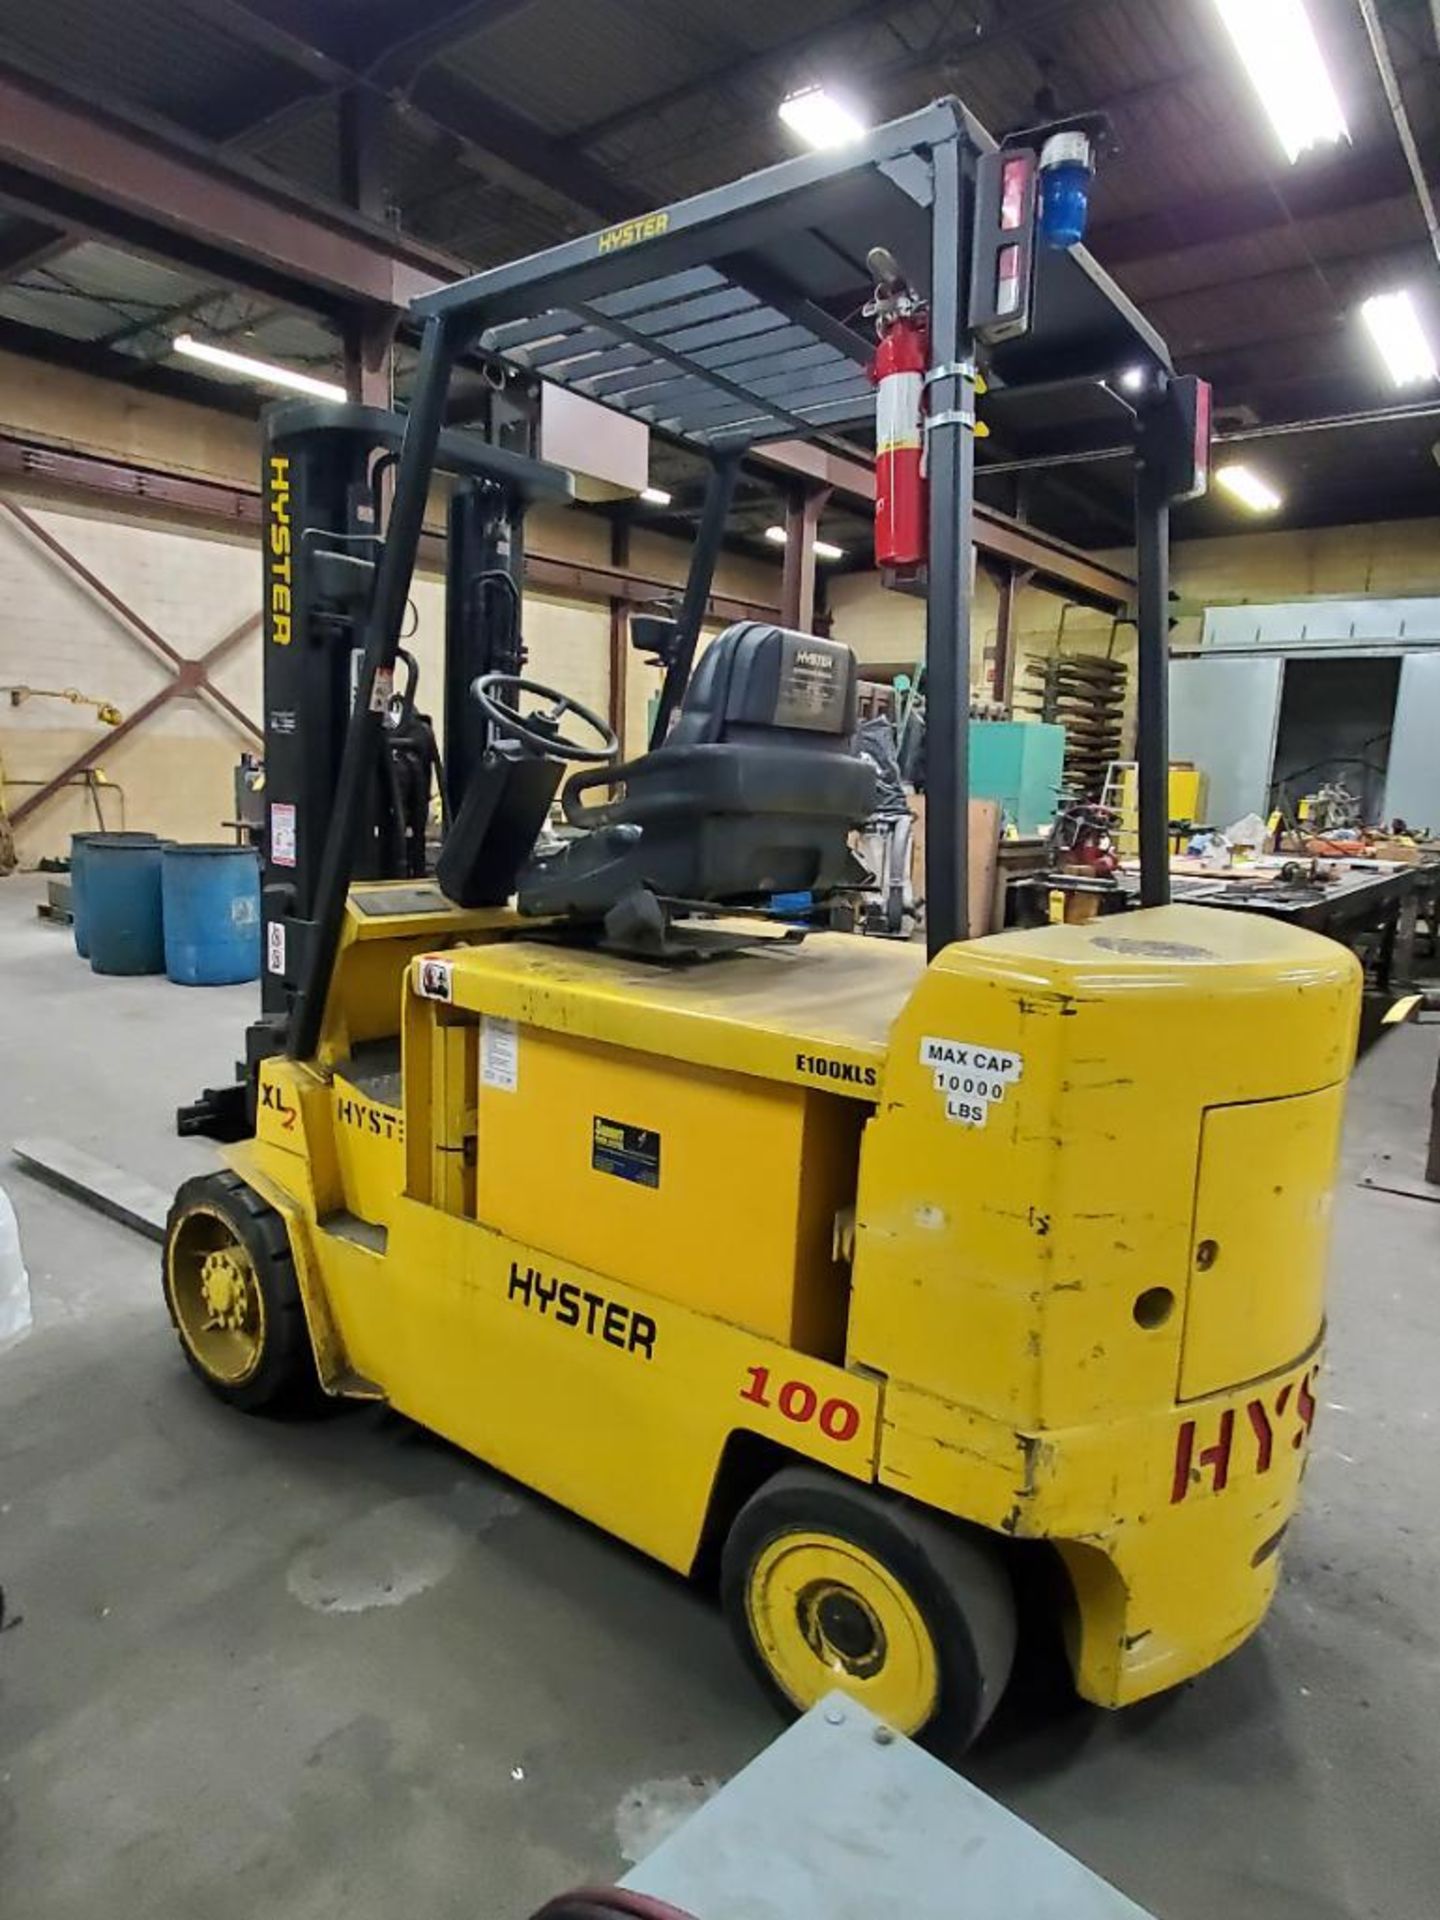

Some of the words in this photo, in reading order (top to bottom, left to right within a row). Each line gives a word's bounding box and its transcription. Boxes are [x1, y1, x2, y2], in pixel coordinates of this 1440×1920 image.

[598, 212, 669, 254] HYSTER
[270, 457, 292, 646] HYSTER
[796, 1053, 877, 1086] E100XLS
[928, 1044, 968, 1066] MAX
[973, 1052, 1013, 1072] CAP
[937, 1073, 1003, 1099] 10000
[947, 1101, 983, 1121] LBS
[508, 1262, 656, 1360] HYSTER
[739, 1366, 860, 1441] 100
